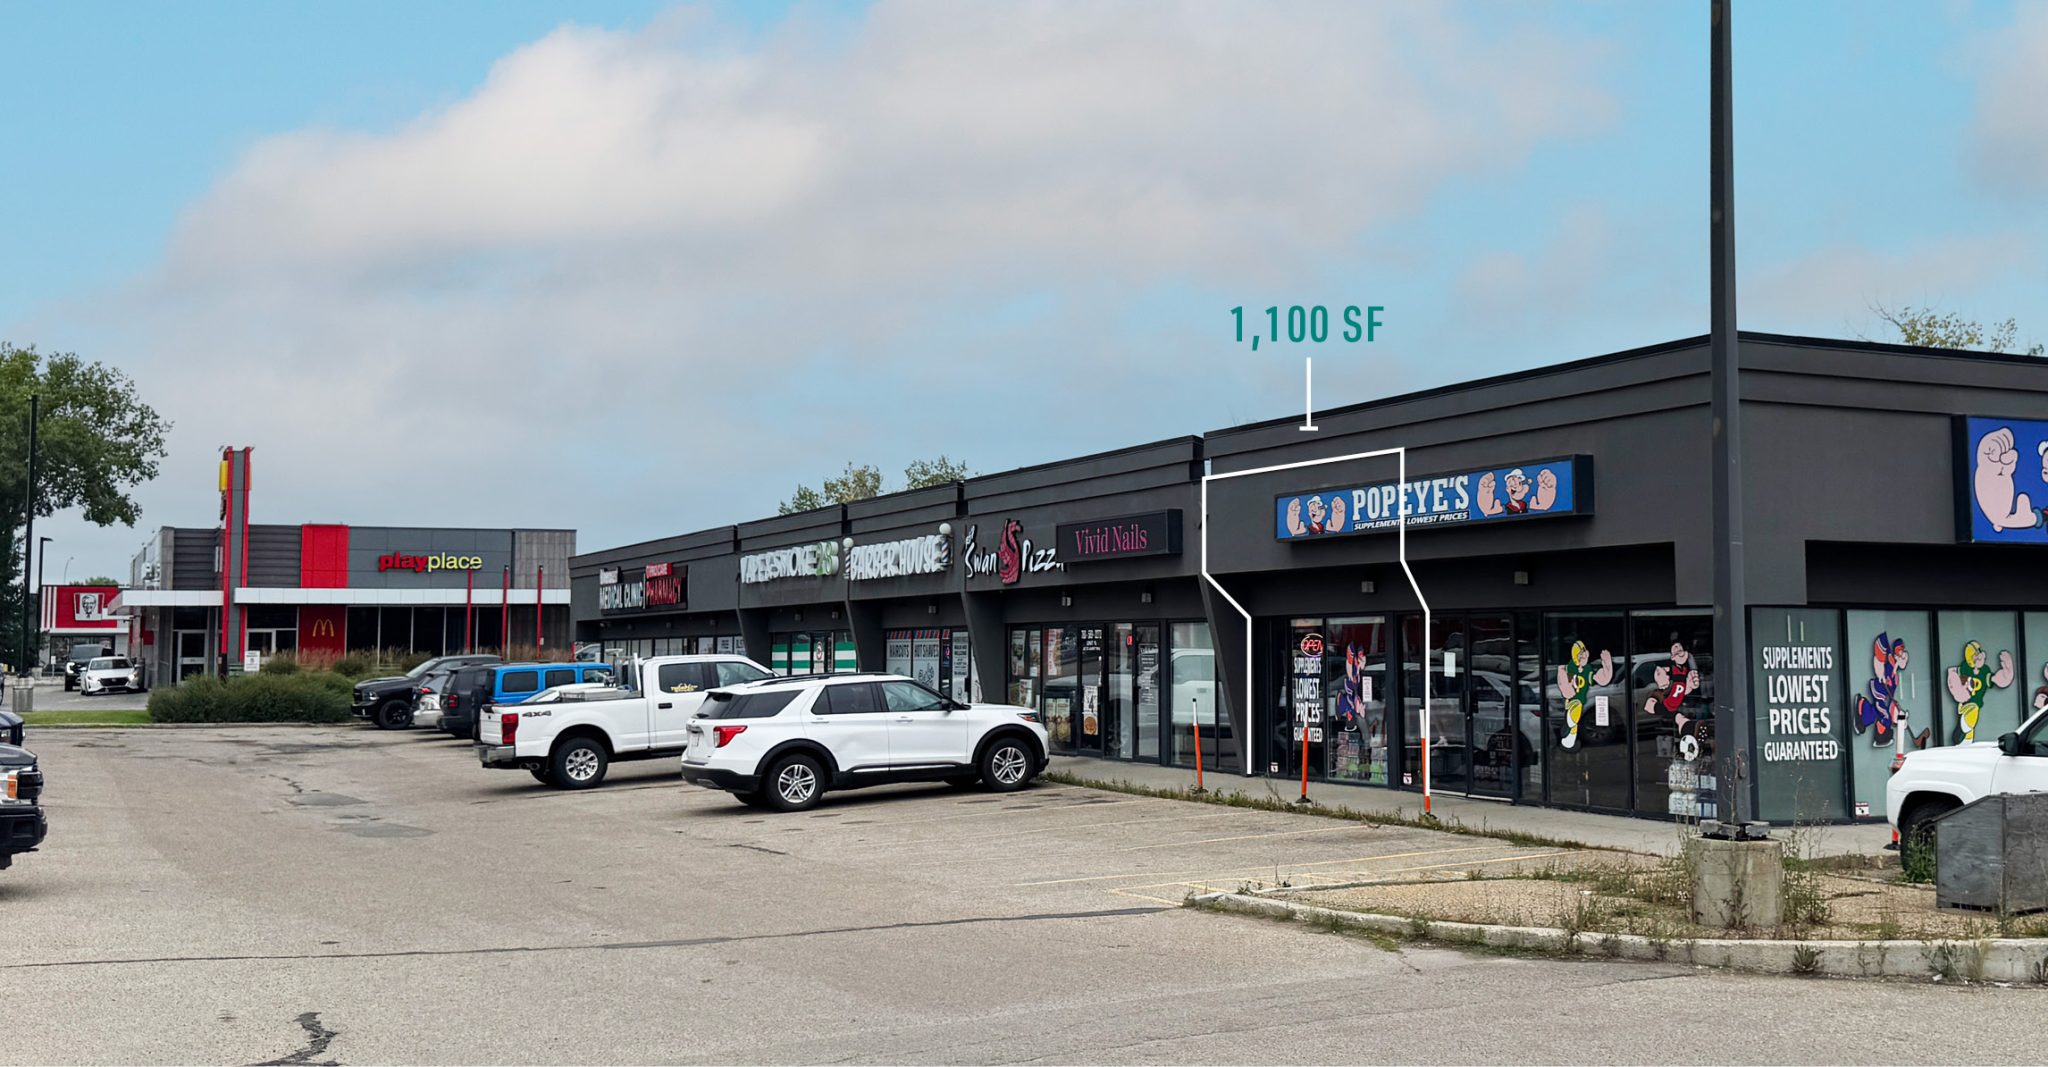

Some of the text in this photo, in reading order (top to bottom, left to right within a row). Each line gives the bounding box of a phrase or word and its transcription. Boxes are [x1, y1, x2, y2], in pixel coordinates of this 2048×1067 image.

[1352, 475, 1470, 521] POPEYE'S
[1407, 513, 1438, 525] LOWEST
[1439, 511, 1469, 521] PRICES
[1075, 524, 1148, 555] Vivid Nails
[378, 550, 482, 573] playplace
[851, 542, 900, 581] BARBER
[899, 535, 944, 575] HOUSE
[965, 542, 997, 578] Swan
[1763, 646, 1833, 669] SUPPLEMENTS
[1296, 678, 1320, 699] LOWEST
[1768, 675, 1829, 703] LOWEST
[1769, 707, 1831, 735] PRICES
[1764, 740, 1839, 761] GUARANTEED
